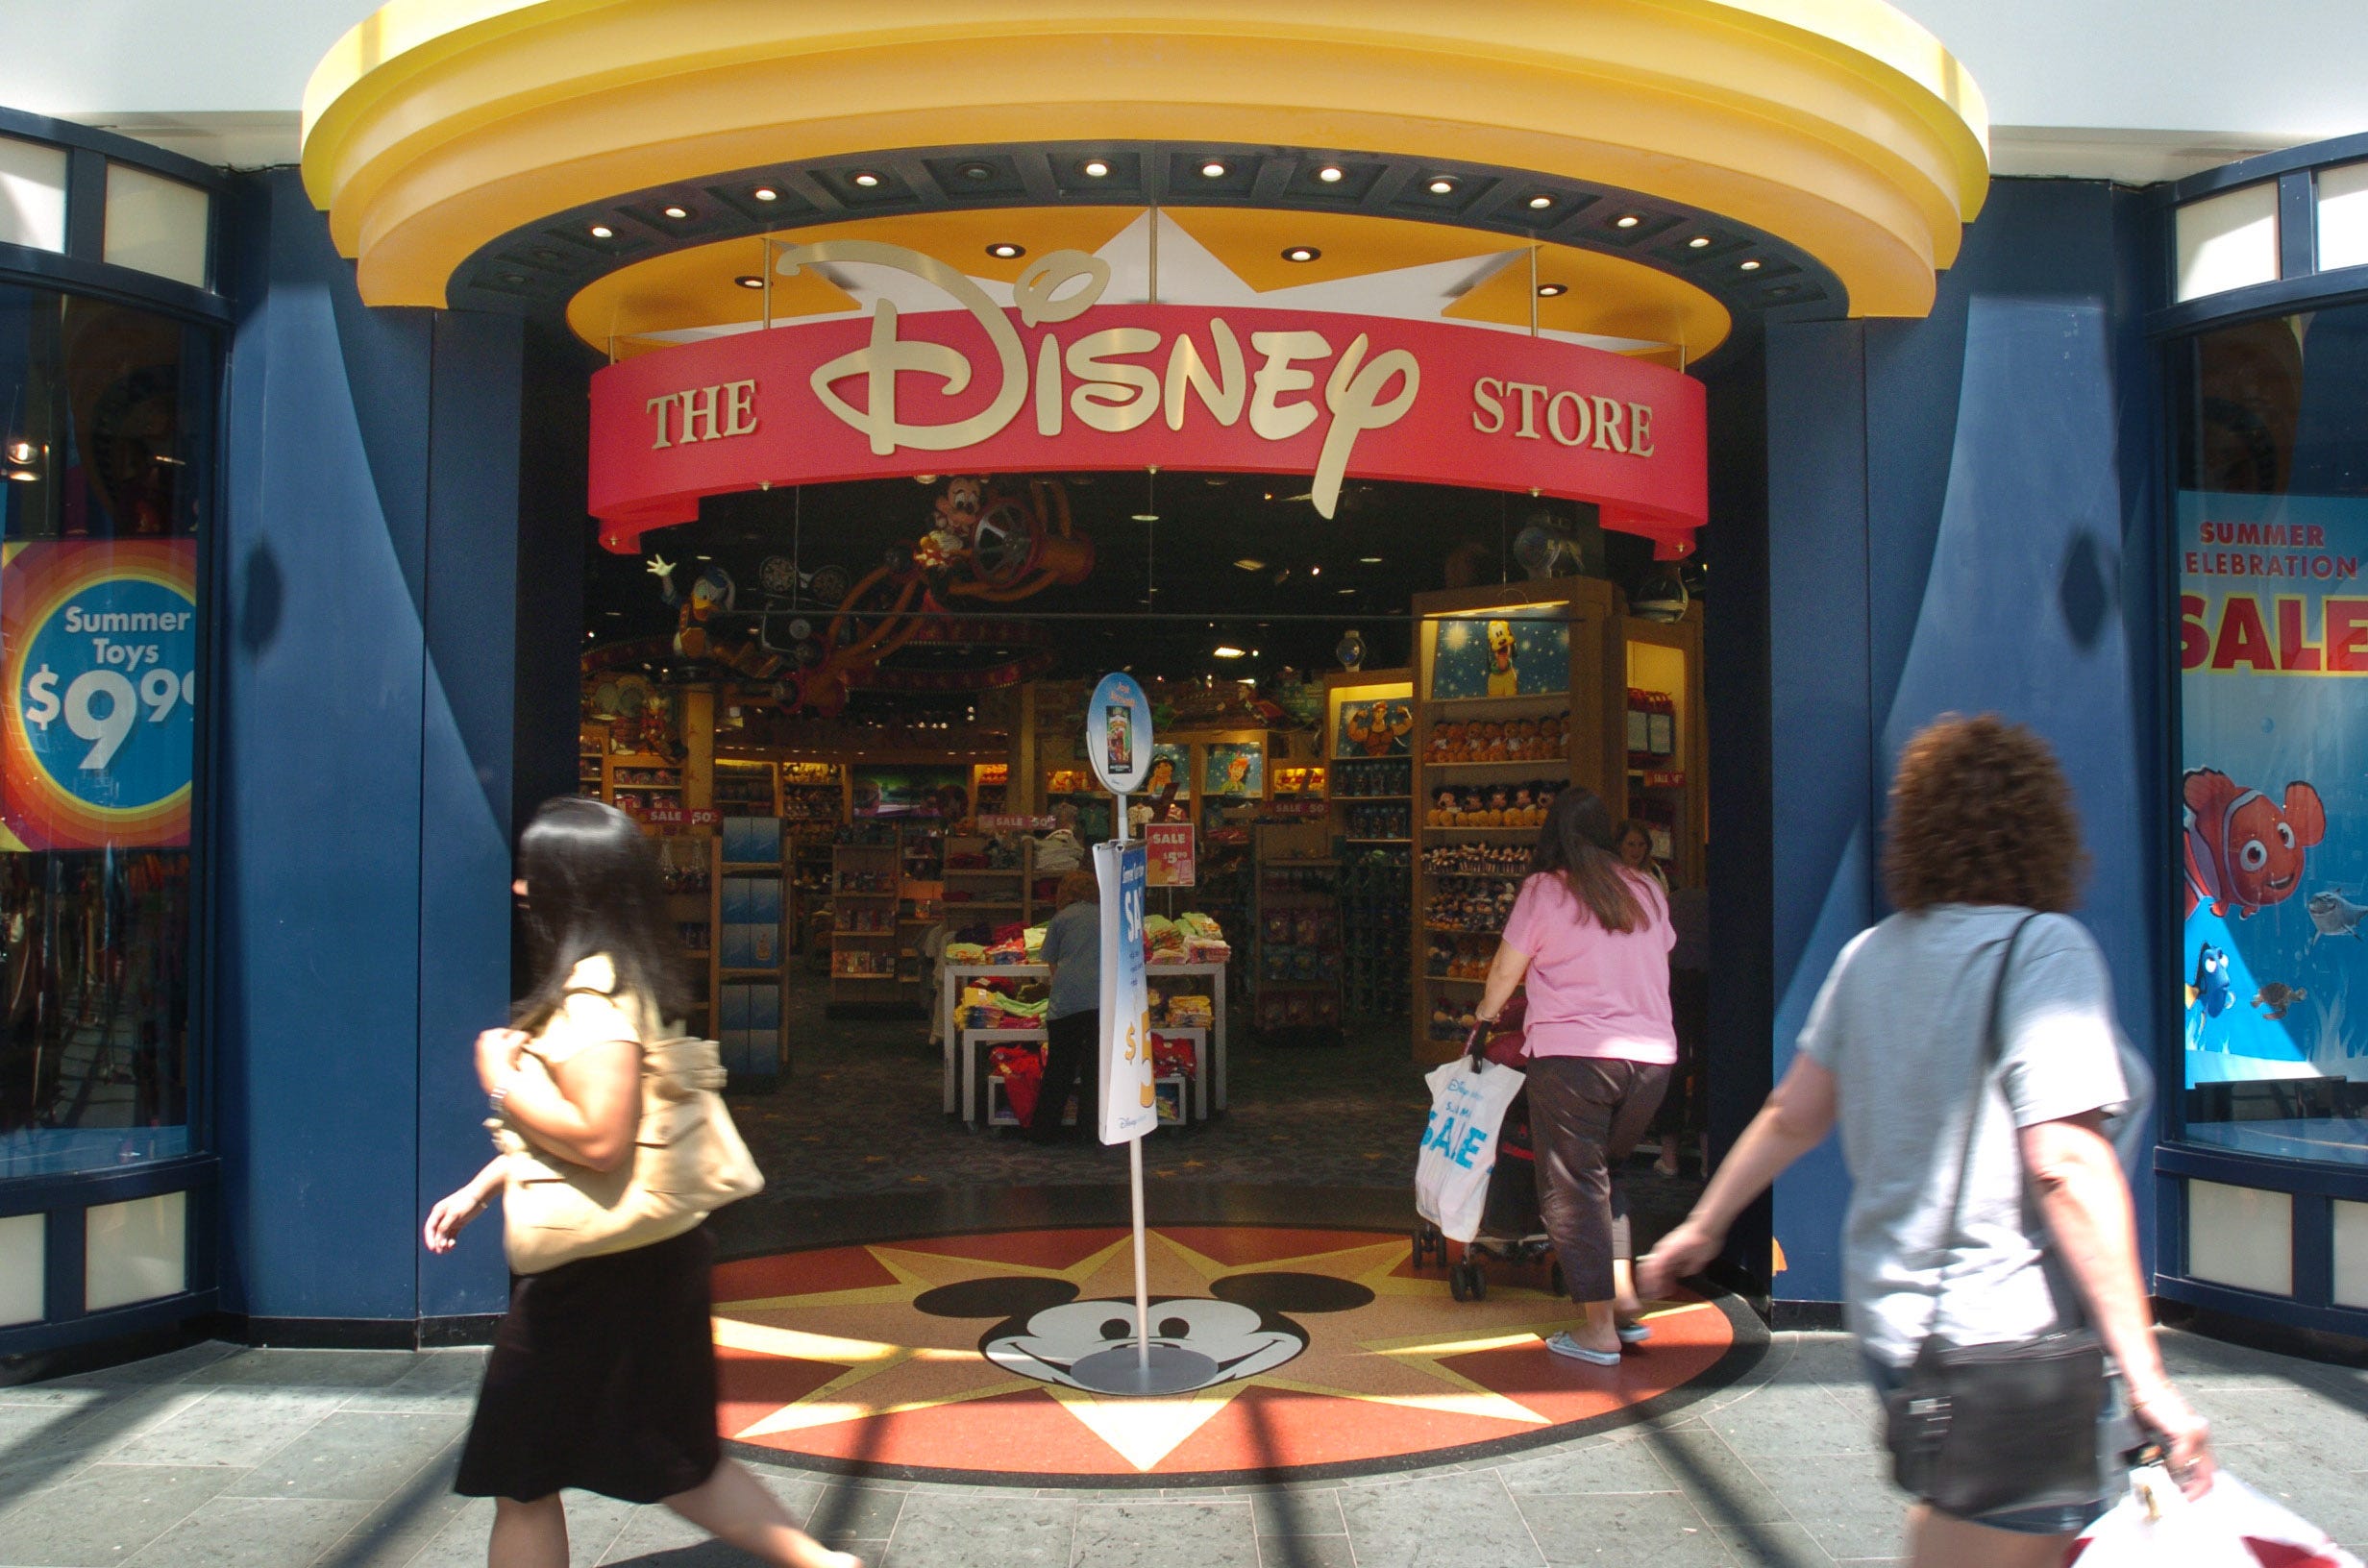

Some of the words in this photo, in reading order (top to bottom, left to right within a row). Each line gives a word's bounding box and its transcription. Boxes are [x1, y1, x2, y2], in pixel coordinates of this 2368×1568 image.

[647, 379, 757, 451] THE
[1471, 377, 1655, 458] STORE
[2200, 521, 2326, 548] SUMMER
[2180, 552, 2358, 579] ELEBRATION
[64, 606, 191, 632] Summer
[2181, 591, 2368, 677] SALE
[93, 638, 160, 672] Toys
[650, 811, 682, 821] SALE
[996, 818, 1024, 826] SALE
[1153, 833, 1186, 845] SALE
[1124, 887, 1143, 943] SA
